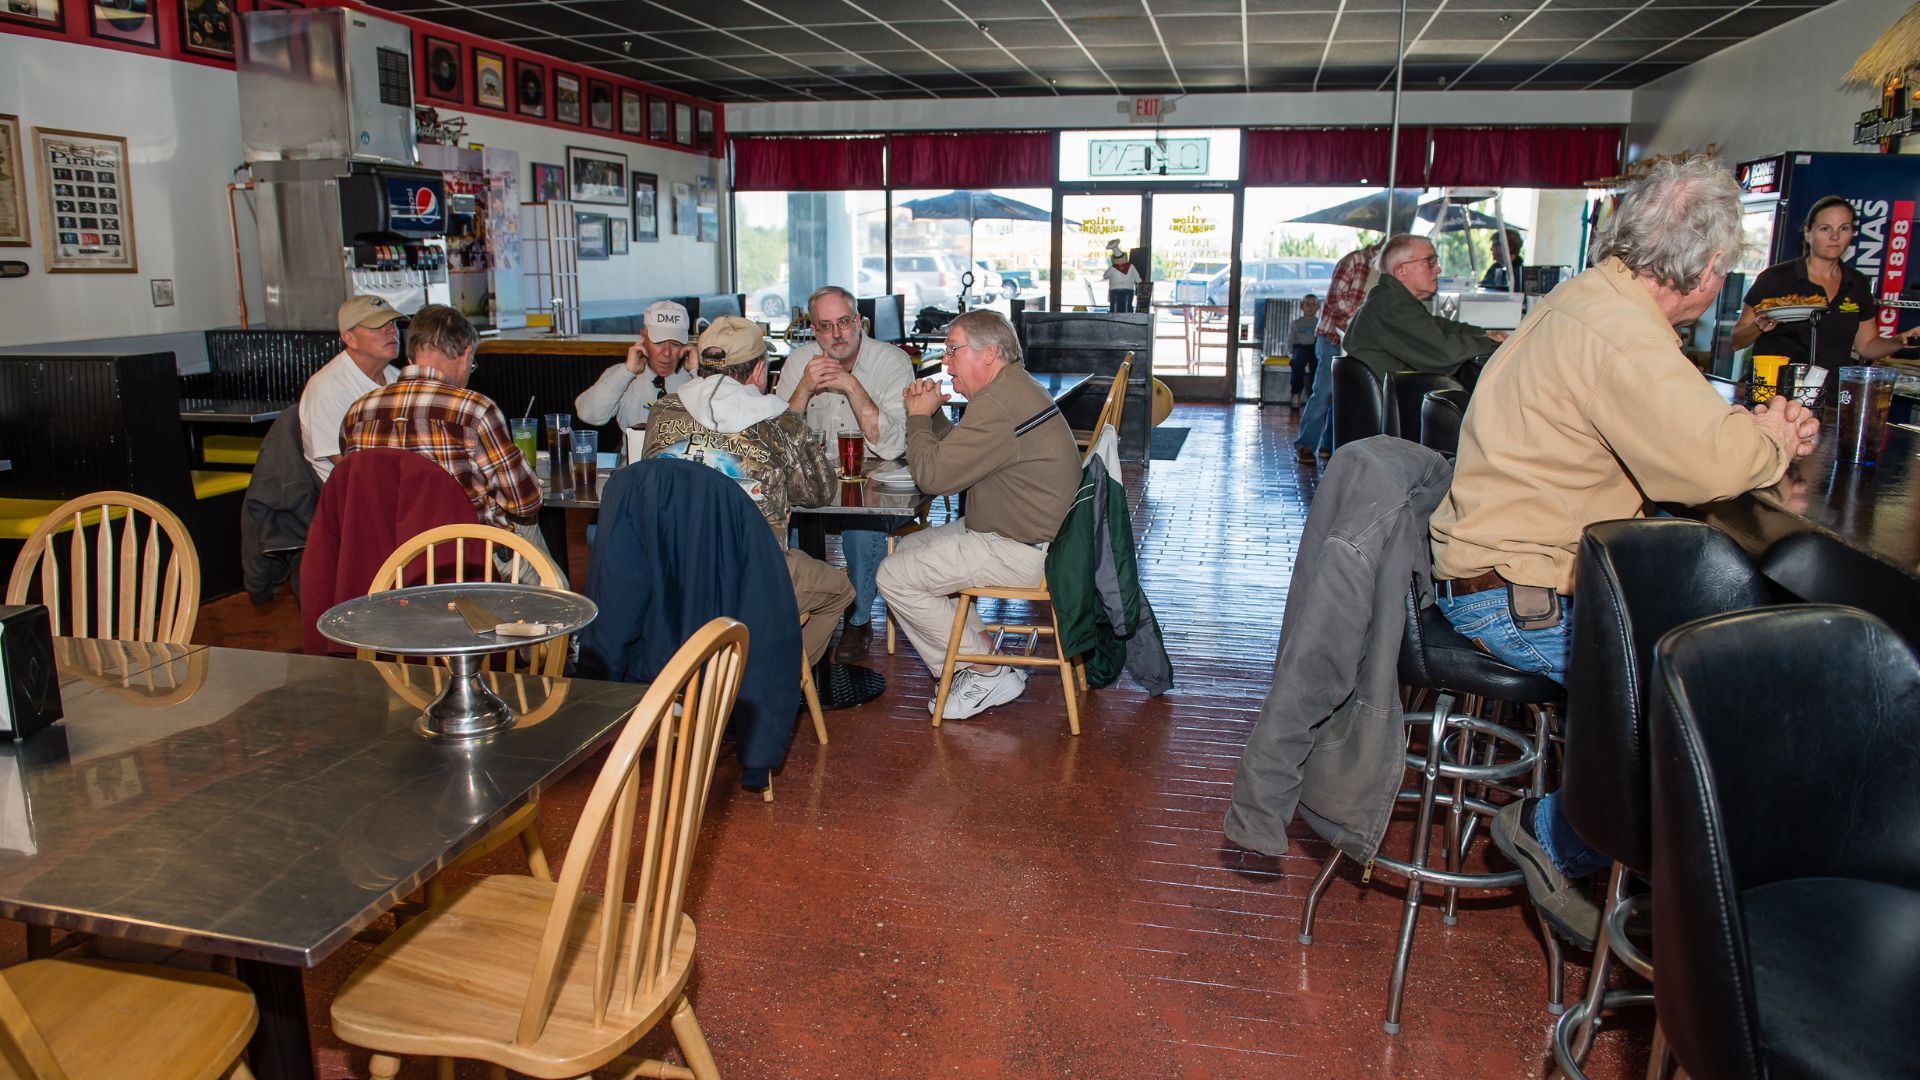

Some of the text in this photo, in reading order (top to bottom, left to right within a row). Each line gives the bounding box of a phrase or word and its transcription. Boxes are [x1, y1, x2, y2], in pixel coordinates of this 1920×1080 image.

[1136, 98, 1160, 117] EXIT
[50, 150, 115, 168] Pirates
[1887, 219, 1909, 280] 1898
[657, 313, 681, 325] DMF
[681, 432, 771, 463] FRAN'S
